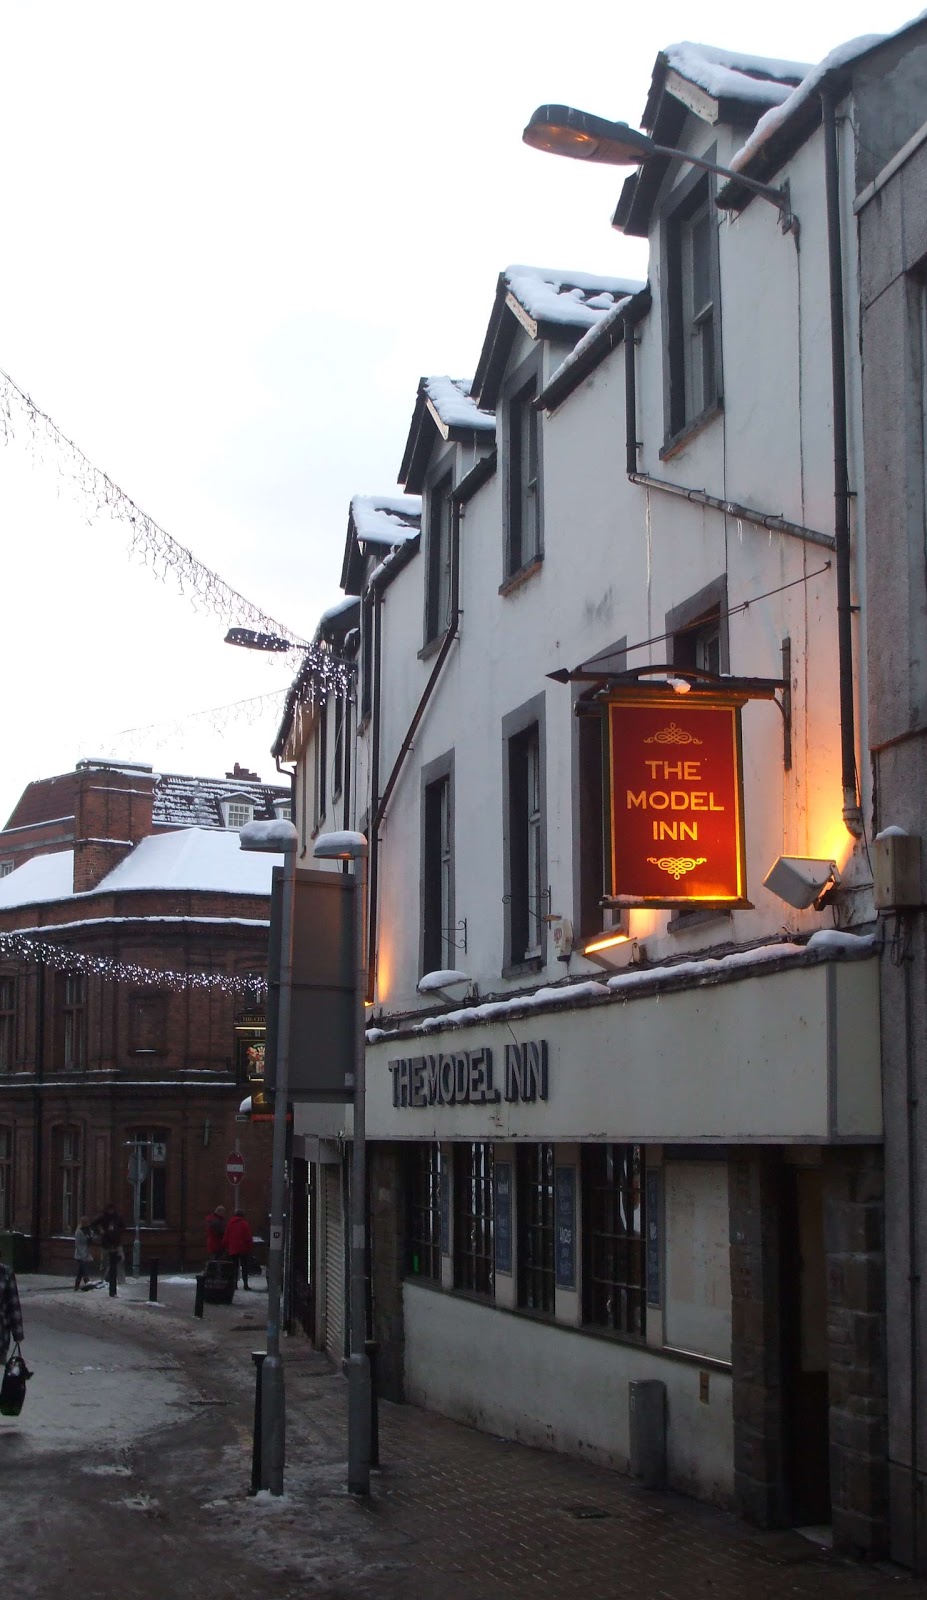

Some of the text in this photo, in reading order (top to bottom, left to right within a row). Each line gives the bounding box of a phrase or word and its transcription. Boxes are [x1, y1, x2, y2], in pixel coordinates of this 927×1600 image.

[645, 760, 701, 781] THE
[626, 790, 725, 811] MODEL
[653, 821, 698, 840] INN
[388, 1040, 549, 1107] THE MODEL INN
